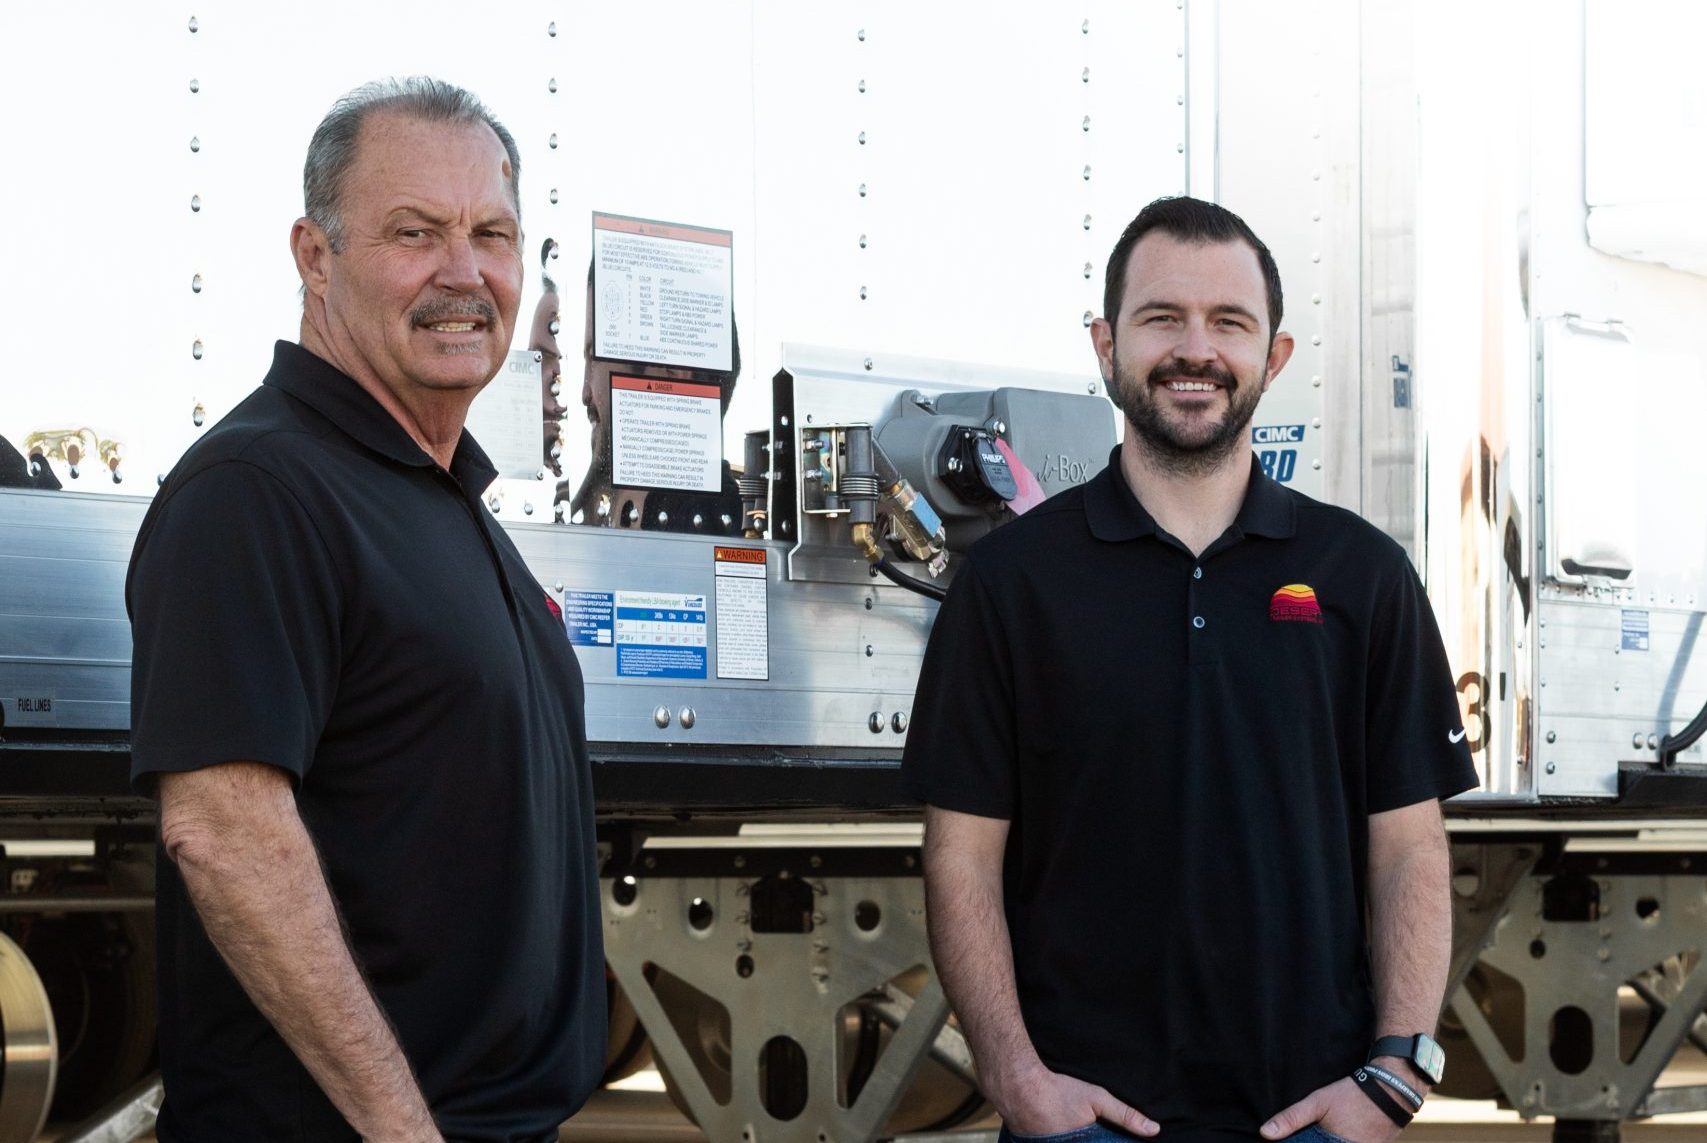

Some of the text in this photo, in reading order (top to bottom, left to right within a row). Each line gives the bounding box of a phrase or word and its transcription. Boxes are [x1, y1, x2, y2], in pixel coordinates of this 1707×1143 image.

[1254, 426, 1299, 442] CIMC
[724, 550, 763, 562] WARNING
[18, 698, 52, 712] FUEL LINES
